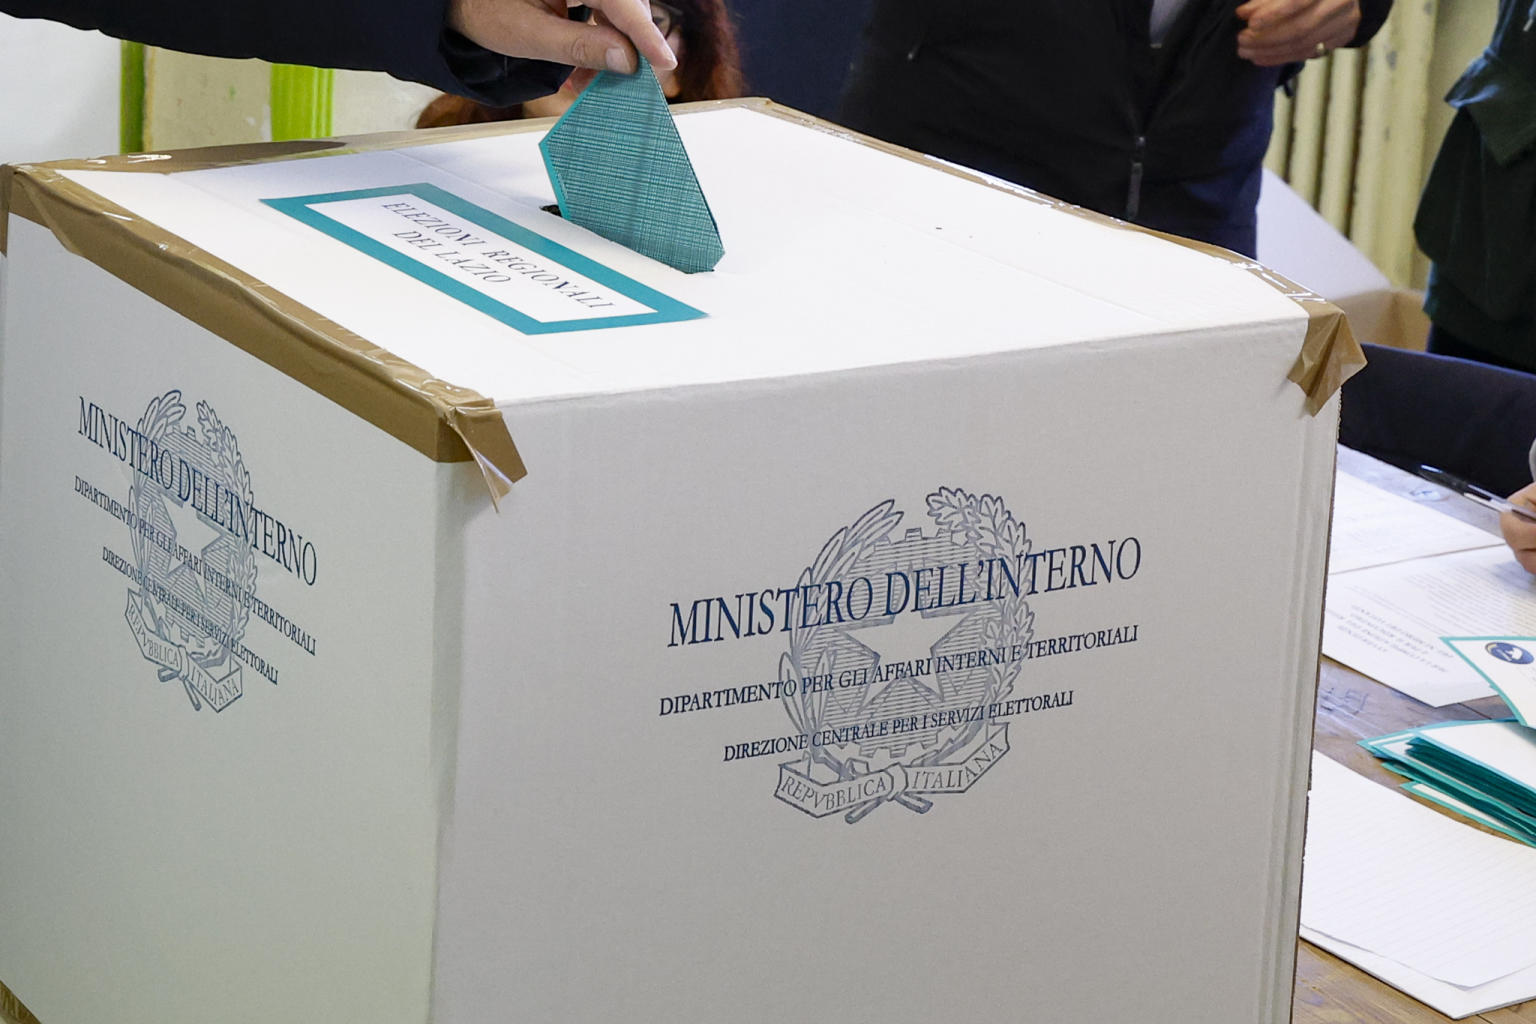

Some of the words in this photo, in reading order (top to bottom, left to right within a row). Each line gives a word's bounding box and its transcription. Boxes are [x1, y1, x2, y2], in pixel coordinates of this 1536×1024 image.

[383, 202, 486, 247] ELEZIONI
[482, 250, 613, 308] REGIONALI
[393, 231, 442, 250] DEL
[435, 250, 511, 283] LAZIO
[78, 396, 174, 490] MINISTERO
[177, 459, 317, 586] DELL'INTERNO
[74, 476, 137, 529] DIPARTIMENTO
[139, 518, 154, 543] PER
[172, 543, 202, 575] AFFARI
[204, 561, 242, 603] INTERNI
[251, 596, 316, 656] TERRITORIALI
[668, 575, 872, 648] MINISTERO
[884, 536, 1141, 616] DELL'INTERNO
[102, 546, 143, 586] DIREZIONE
[231, 637, 278, 685] ELETTORALI
[191, 666, 239, 706] ITALIANA
[659, 680, 797, 716] DIPARTIMENTO
[801, 674, 835, 694] PER
[839, 668, 869, 689] GLI
[872, 658, 931, 683] AFFARI
[936, 646, 1007, 672] INTERNI
[1012, 645, 1022, 662] E
[1026, 625, 1139, 659] TERRITORIALI
[723, 735, 808, 761] DIREZIONE
[812, 724, 888, 748] CENTRALE
[892, 716, 918, 734] PER
[931, 705, 985, 728] SERVIZI
[988, 690, 1074, 719] ELETTORALI
[781, 776, 887, 811] REPVBBLICA
[912, 743, 1004, 789] ITALIANA
